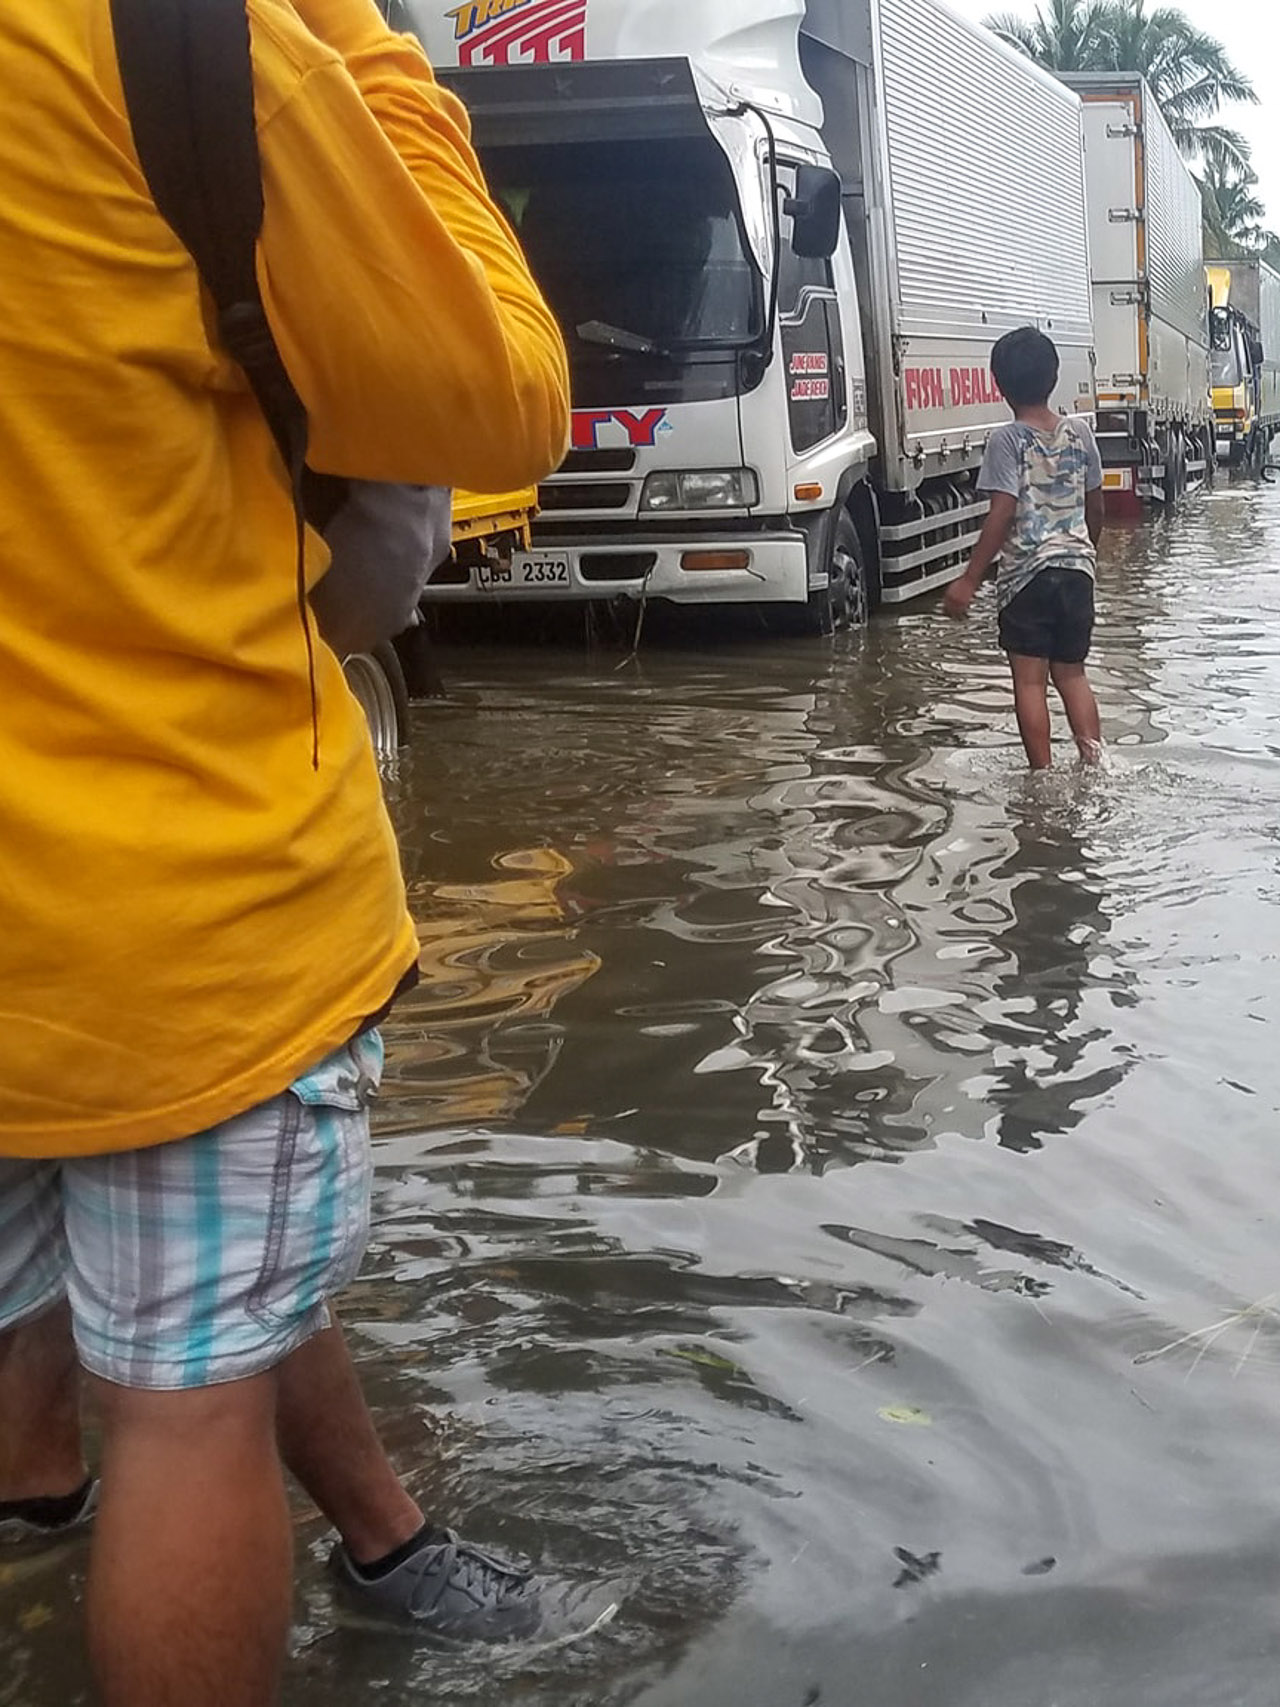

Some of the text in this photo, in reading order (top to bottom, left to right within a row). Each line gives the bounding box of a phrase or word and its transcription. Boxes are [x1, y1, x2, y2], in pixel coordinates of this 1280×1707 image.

[904, 367, 1004, 410] FISH DEALE
[522, 561, 568, 582] 2332
